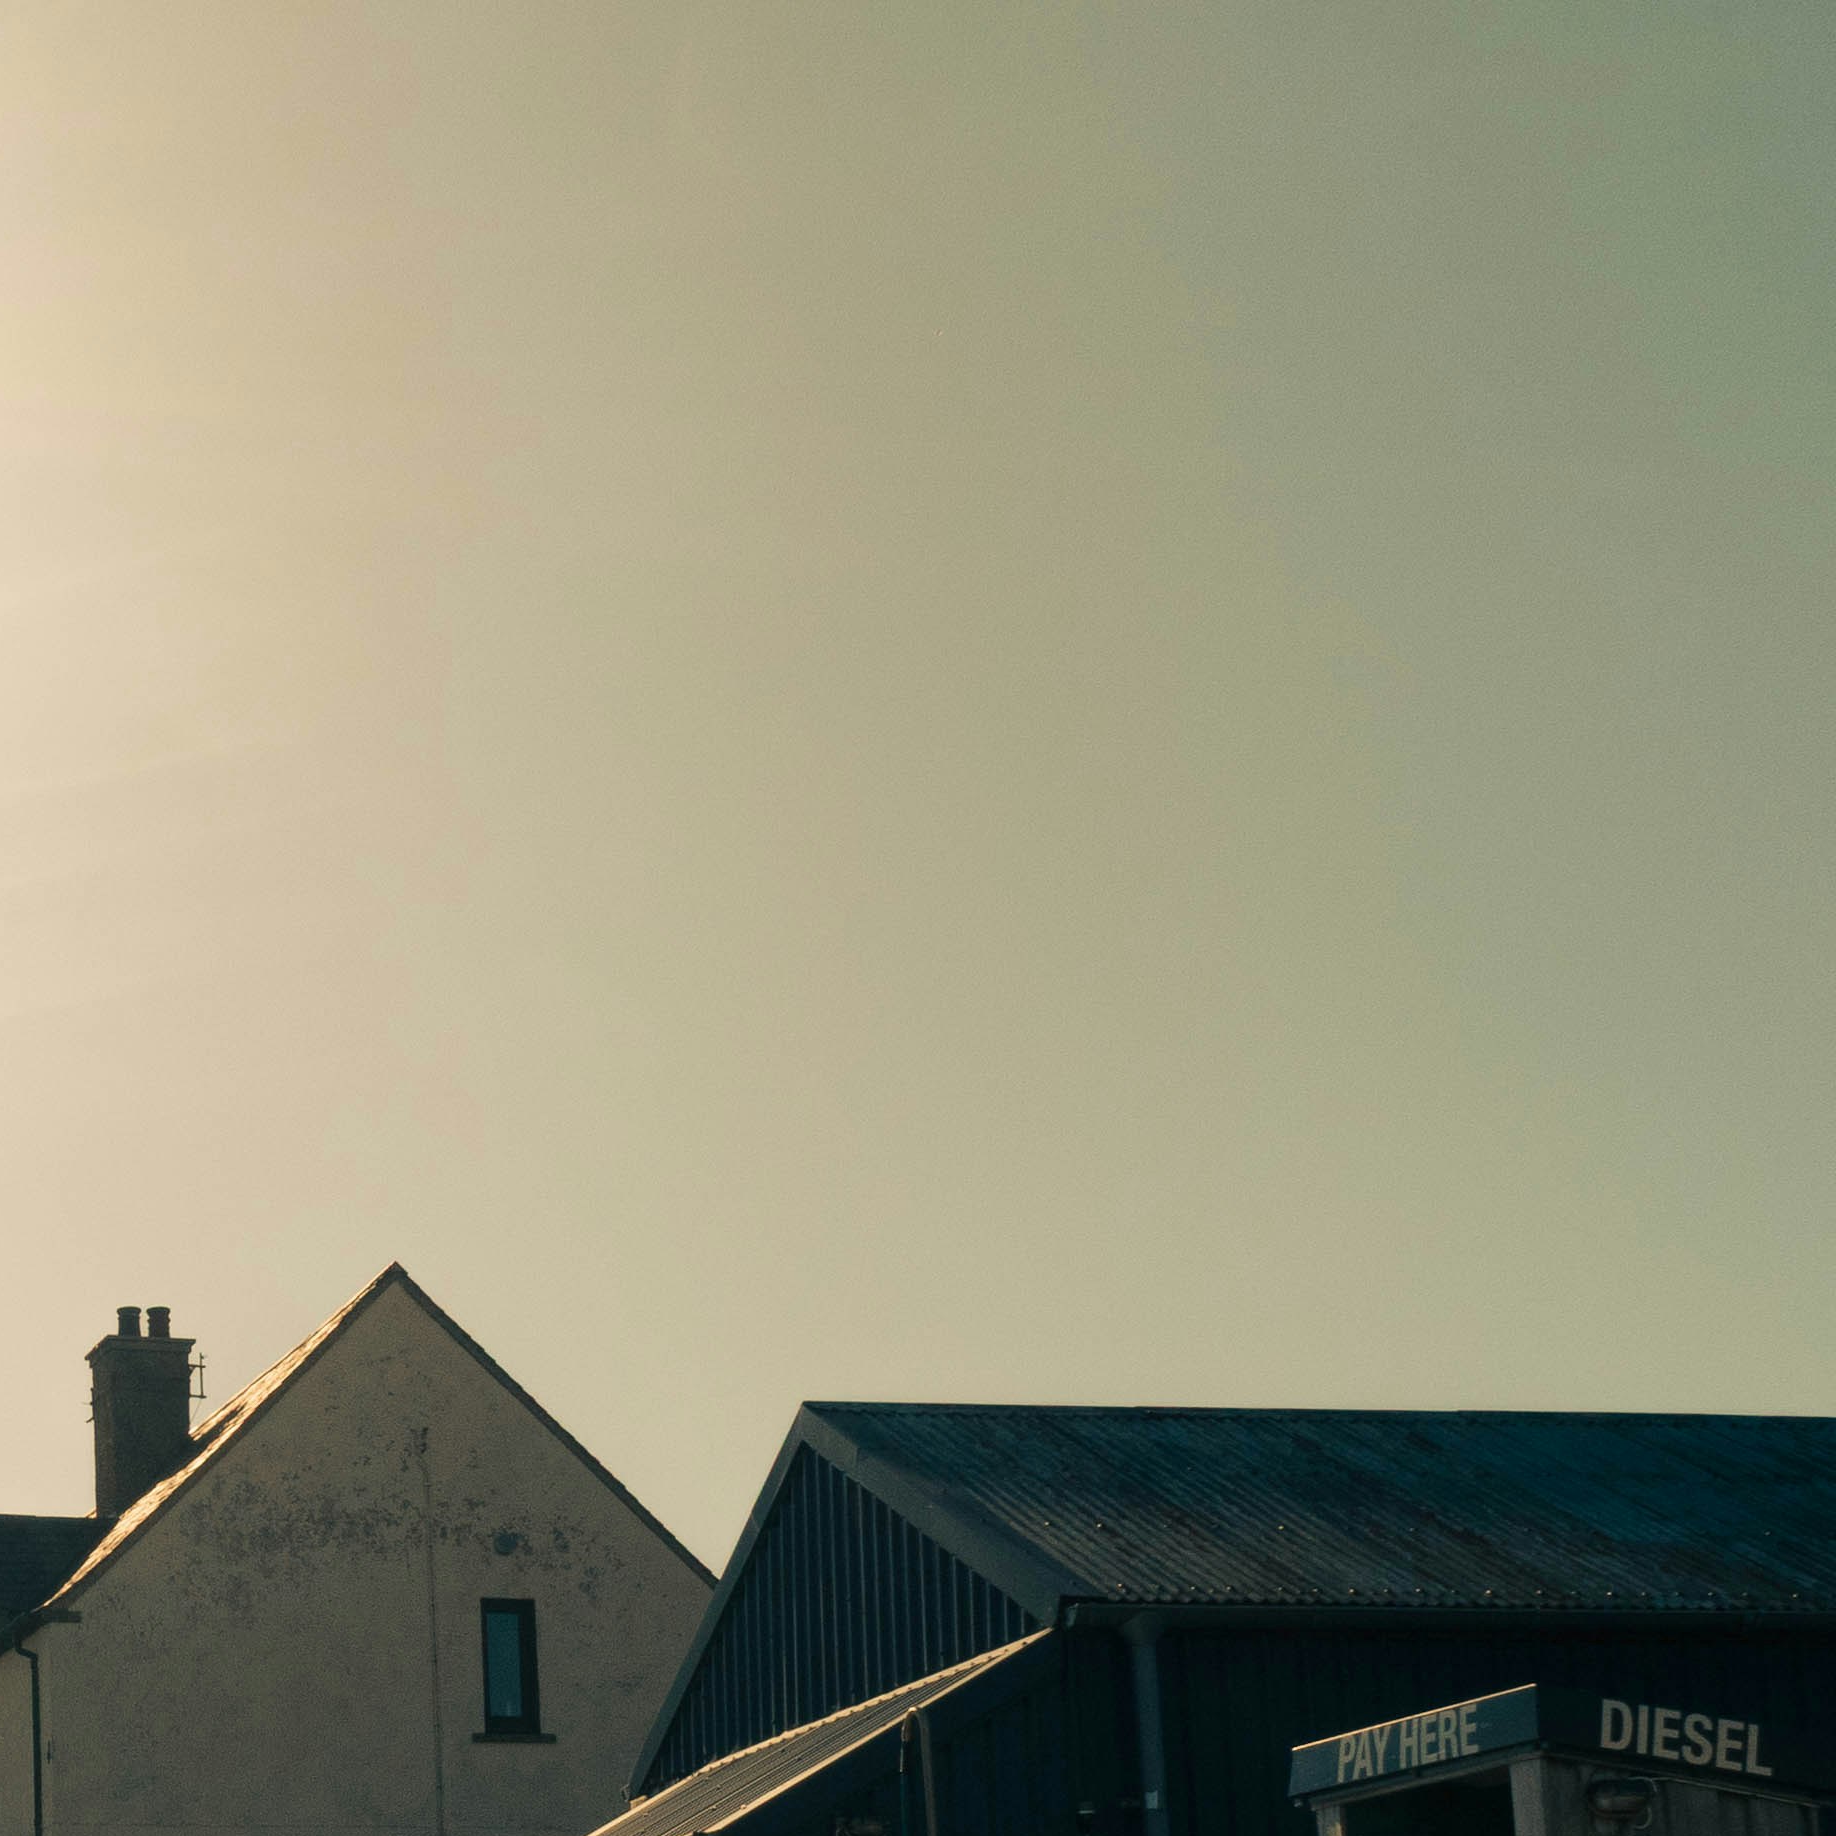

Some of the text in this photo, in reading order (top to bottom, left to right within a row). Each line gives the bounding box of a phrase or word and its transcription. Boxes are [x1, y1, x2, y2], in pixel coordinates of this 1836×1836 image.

[1336, 1703, 1480, 1785] PAY HERE
[1599, 1698, 1773, 1777] DIESEL
